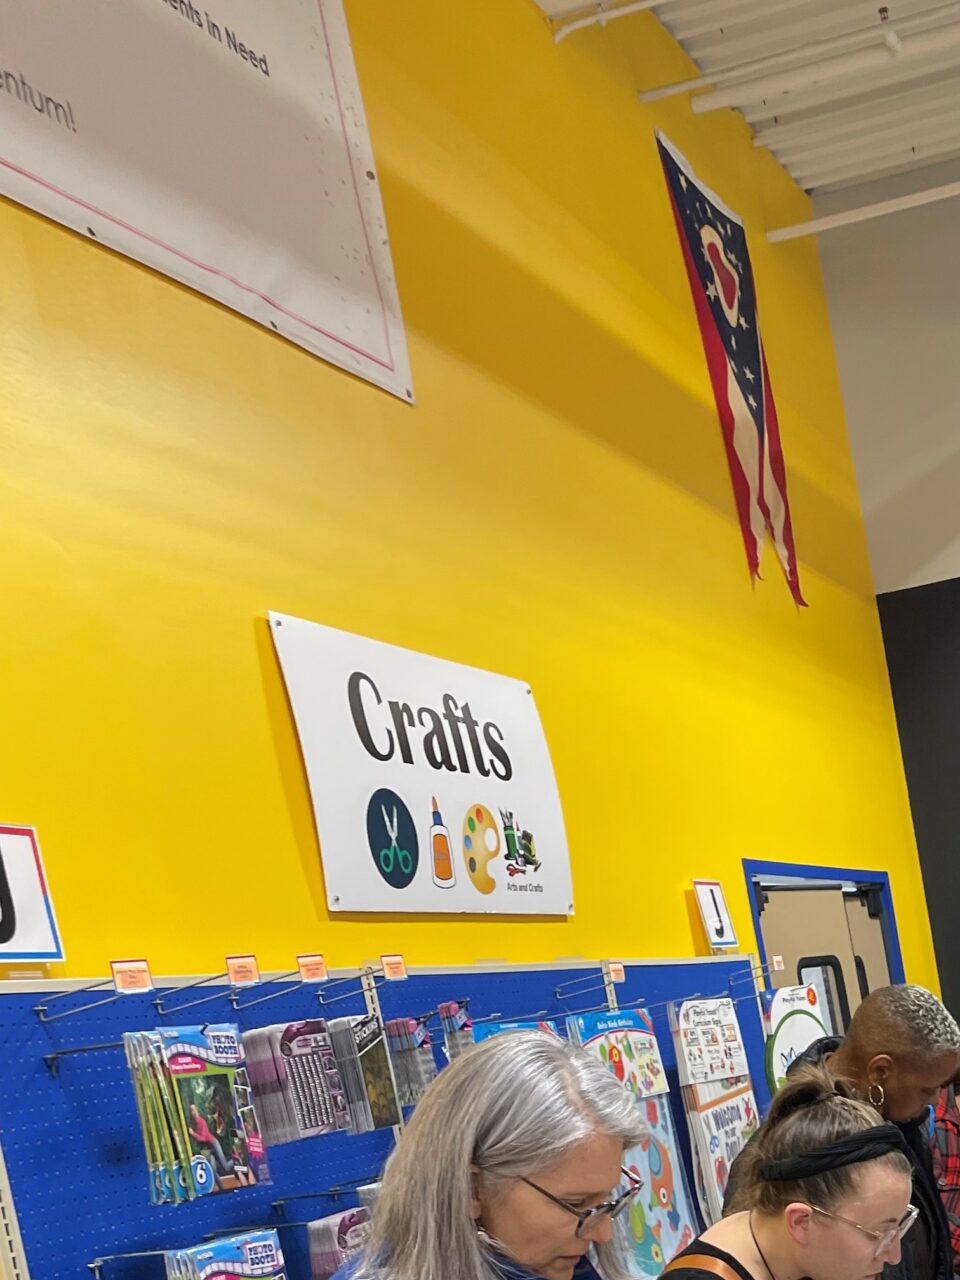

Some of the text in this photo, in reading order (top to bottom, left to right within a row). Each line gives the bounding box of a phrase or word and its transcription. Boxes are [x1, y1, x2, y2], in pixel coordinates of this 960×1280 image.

[162, 0, 203, 28] ents
[225, 26, 270, 77] Need
[0, 70, 77, 133] ntum!
[347, 671, 513, 782] Crafts
[195, 1162, 206, 1183] 6
